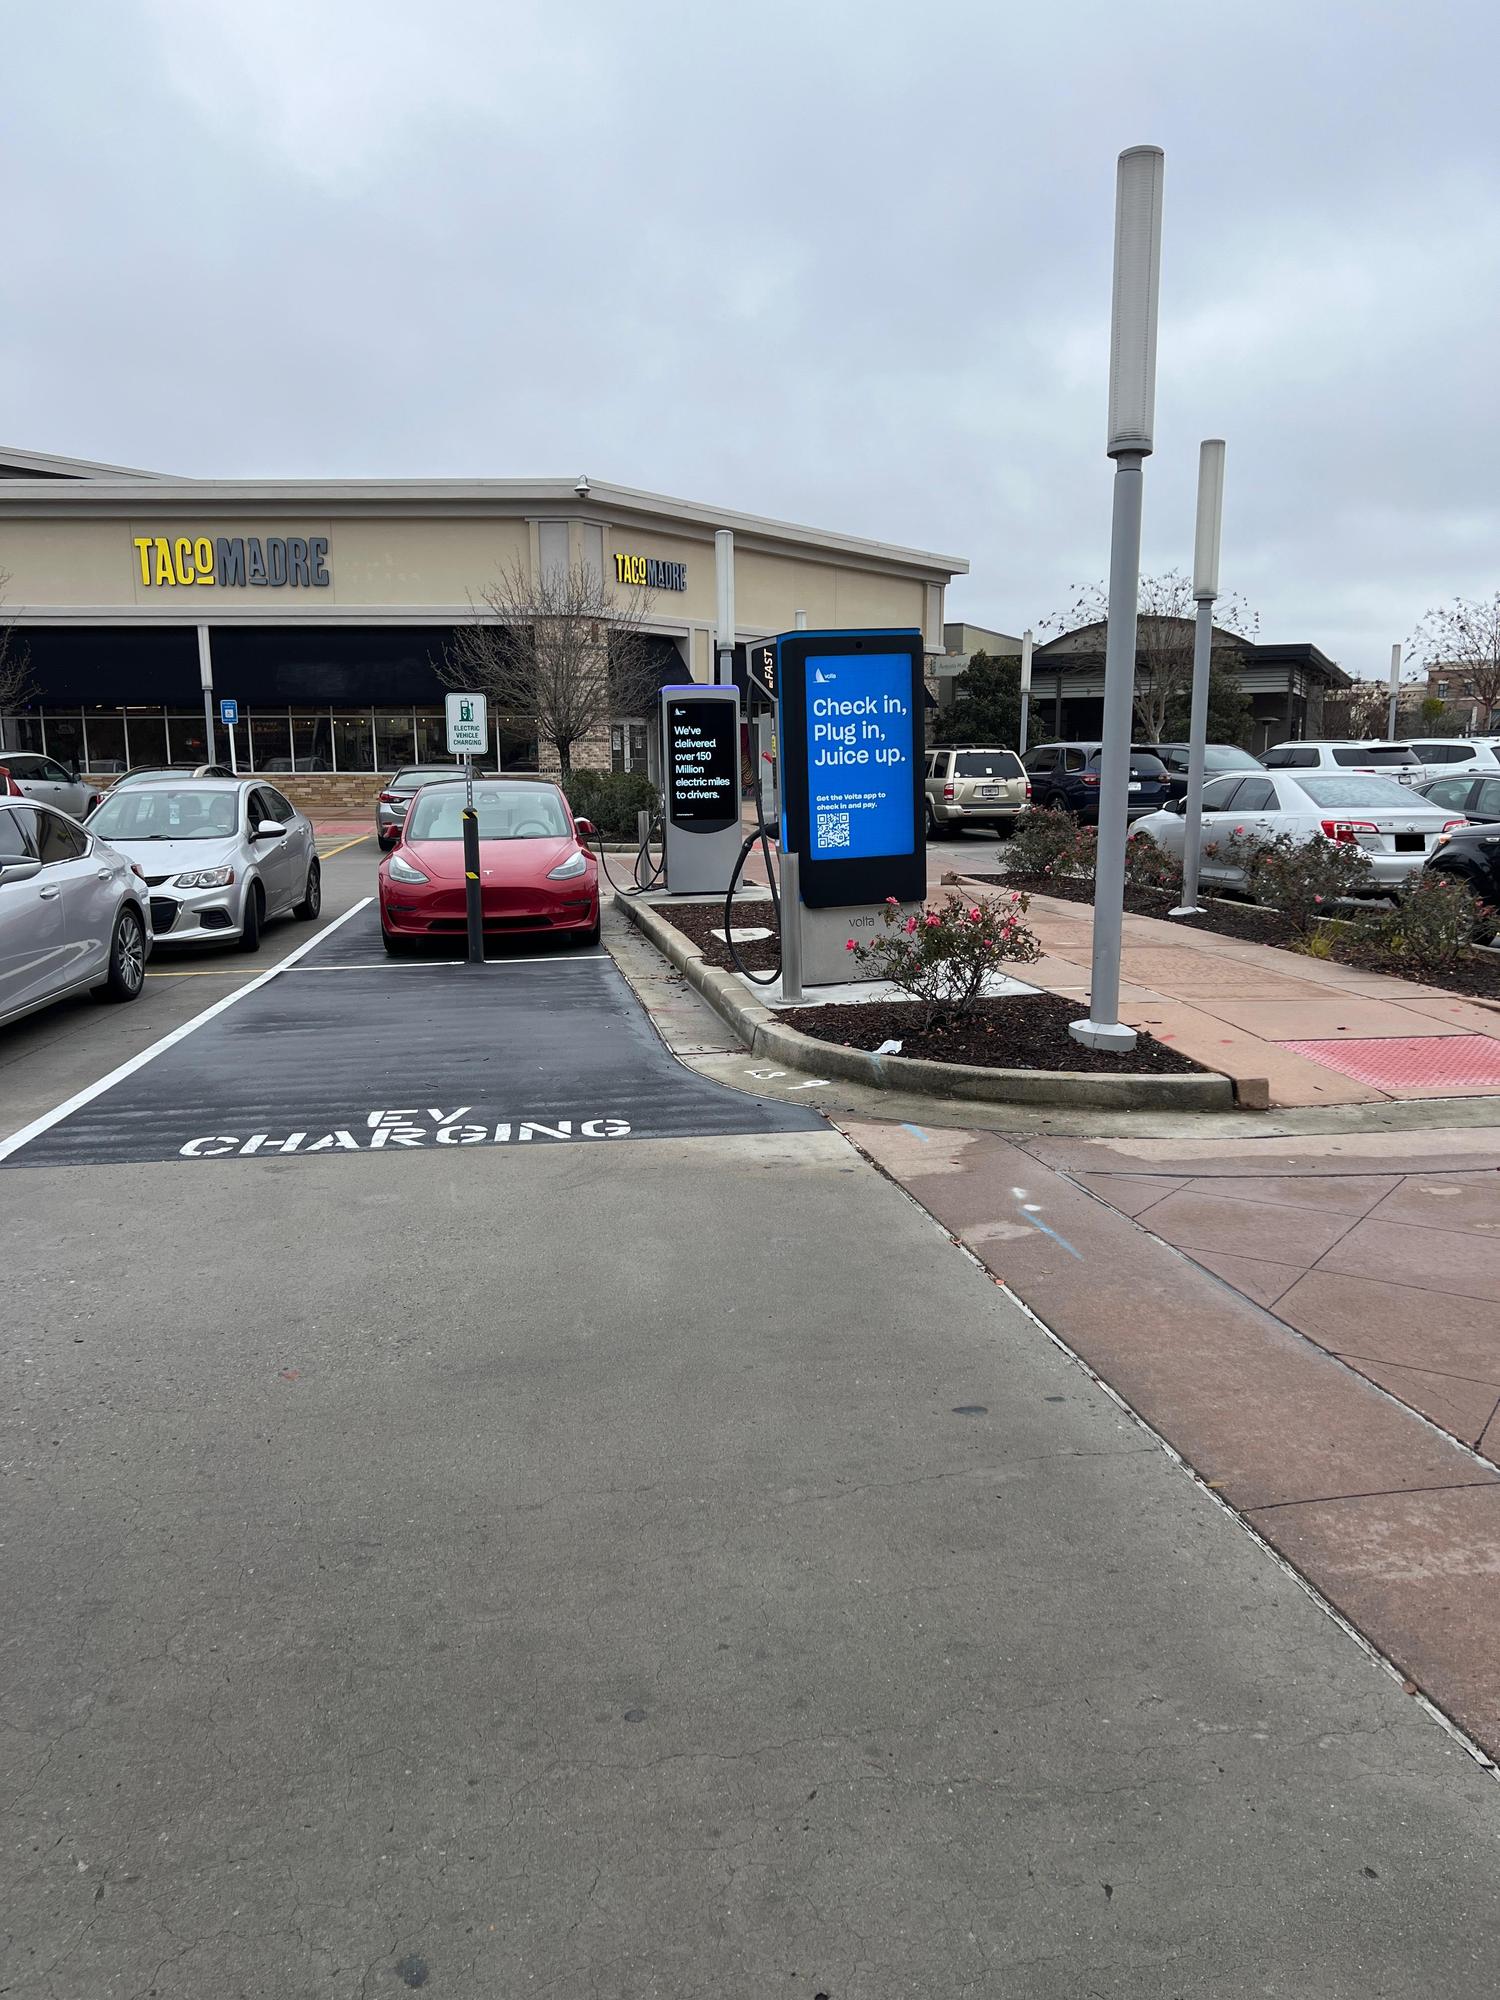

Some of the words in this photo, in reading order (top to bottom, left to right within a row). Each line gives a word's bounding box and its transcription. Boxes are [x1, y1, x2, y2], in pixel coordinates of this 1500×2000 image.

[764, 648, 774, 680] FAST
[813, 696, 878, 716] Check
[883, 694, 907, 715] in,
[674, 726, 702, 735] We've
[814, 723, 857, 745] Plug
[862, 720, 886, 741] in,
[674, 739, 717, 748] delivered
[675, 753, 695, 761] over
[696, 752, 712, 761] 150
[814, 746, 869, 766] Juice
[875, 747, 906, 766] up.
[675, 765, 705, 774] Million
[675, 777, 708, 786] electric
[708, 776, 731, 786] miles
[676, 791, 686, 799] to
[687, 790, 720, 799] drivers.
[816, 794, 830, 802] Get
[816, 803, 839, 811] check
[862, 802, 878, 810] pay.
[848, 916, 875, 928] volta
[367, 1106, 472, 1129] EV
[178, 1119, 632, 1156] CHARGING
